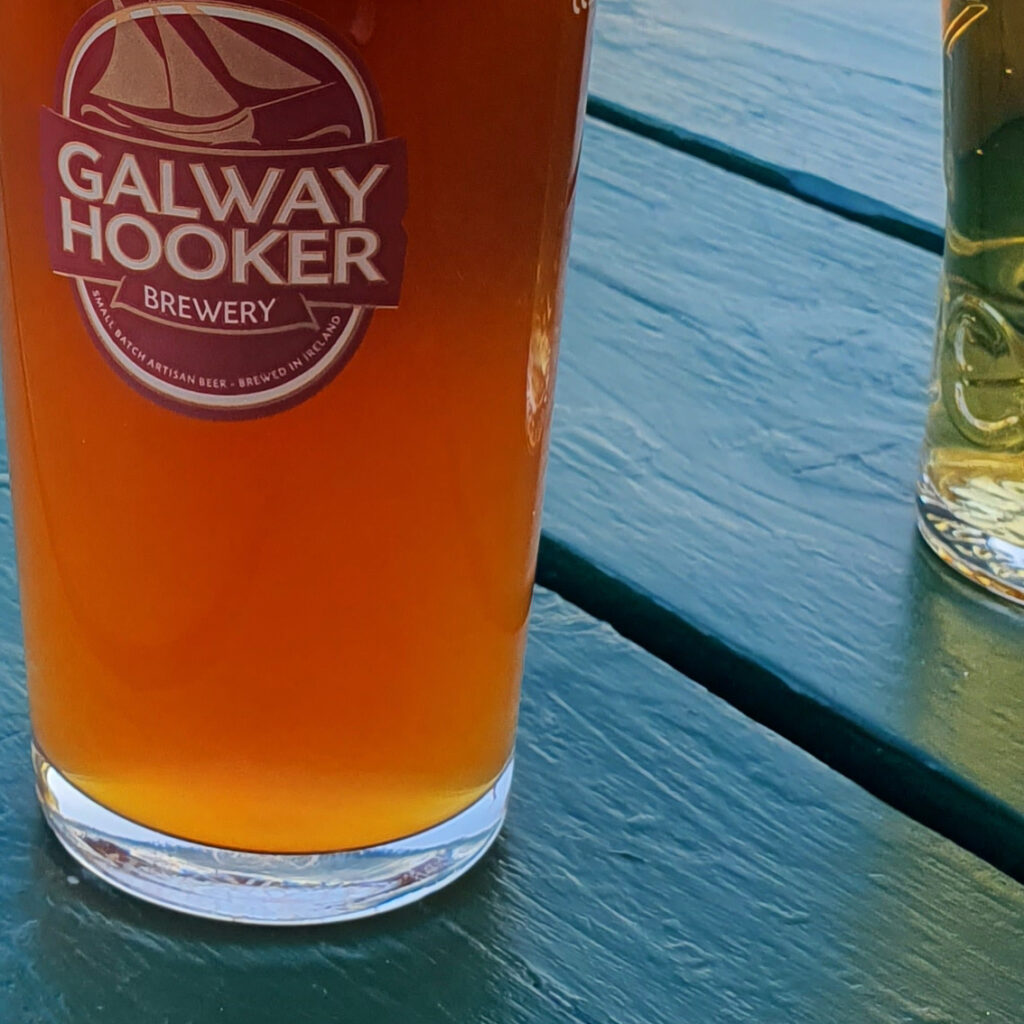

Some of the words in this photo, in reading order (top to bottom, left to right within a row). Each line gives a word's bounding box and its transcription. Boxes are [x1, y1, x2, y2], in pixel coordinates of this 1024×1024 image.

[57, 141, 390, 225] GALWAY
[59, 196, 388, 285] HOOKER
[91, 289, 116, 329] SMALL
[114, 329, 146, 361] BATCH
[147, 358, 196, 384] ARTISAN
[198, 376, 229, 390] BEER
[238, 367, 287, 388] BREWED
[289, 358, 303, 373] IN
[302, 315, 342, 361] IRELAND
[144, 285, 277, 324] BREWERY
